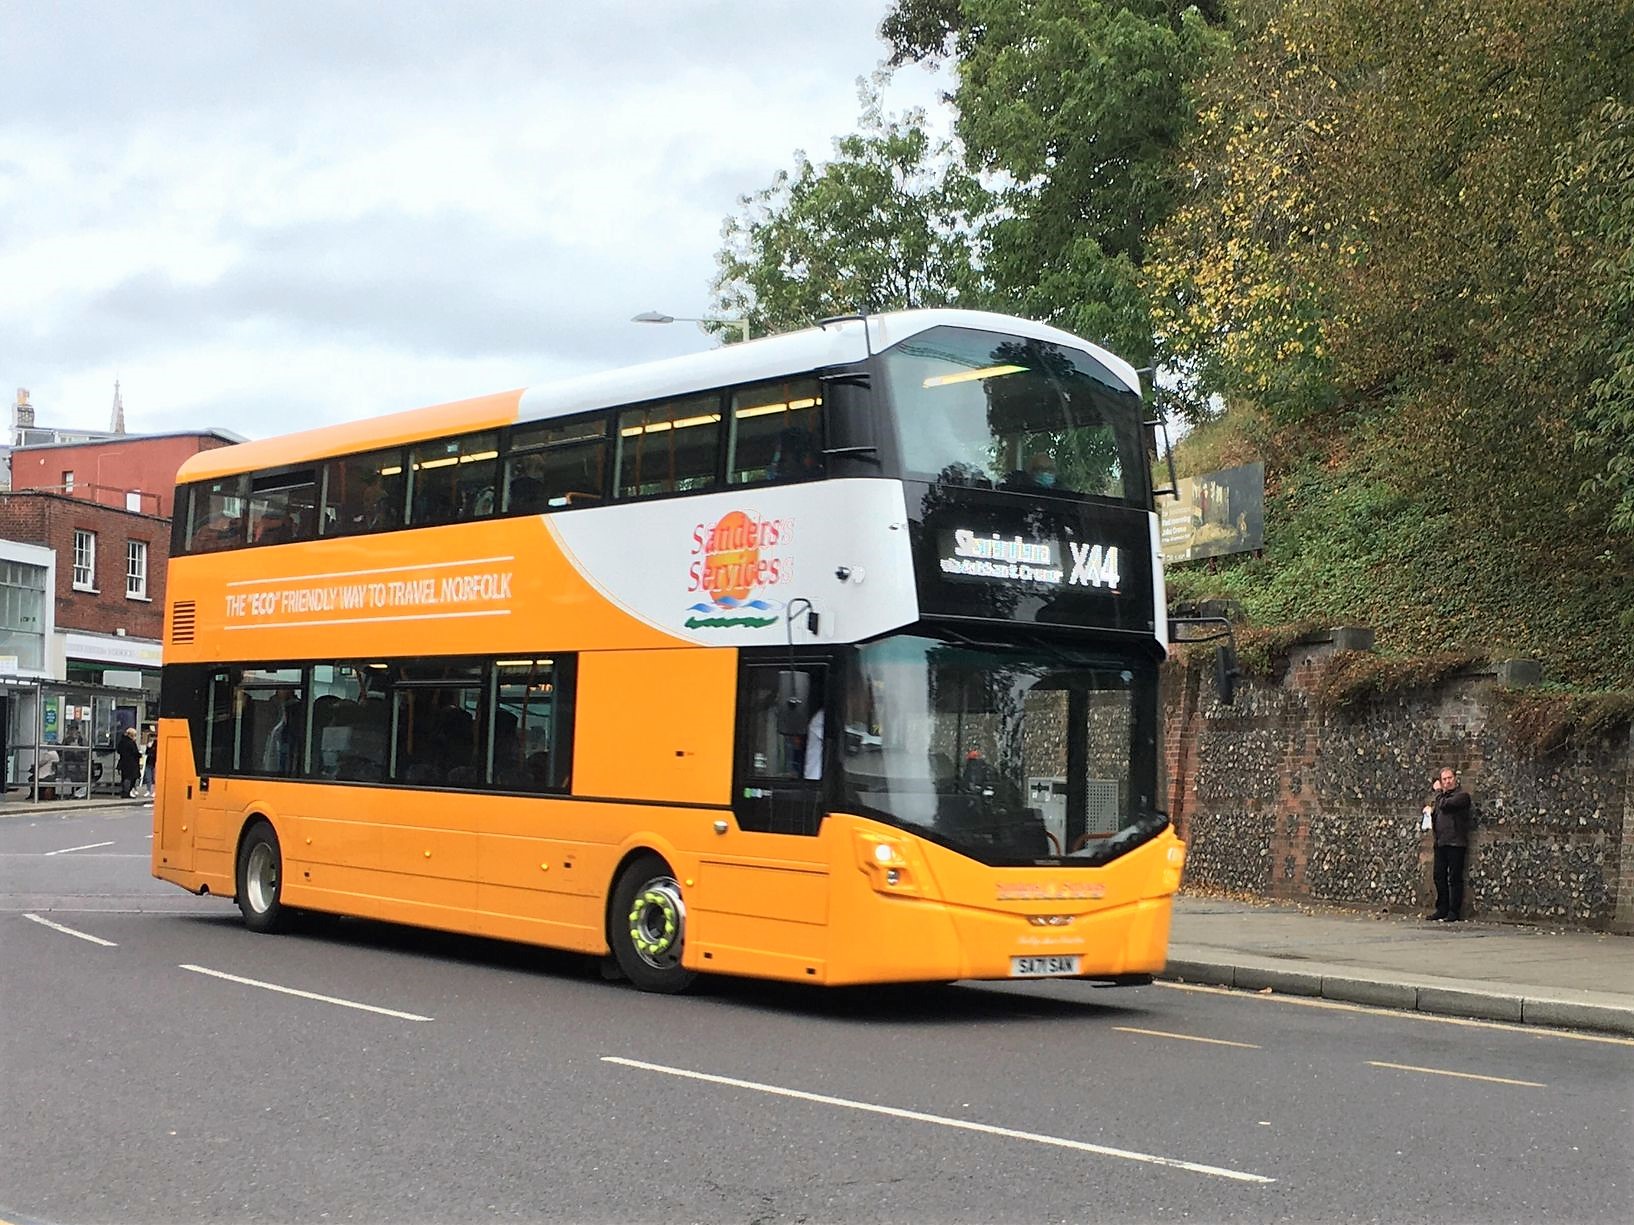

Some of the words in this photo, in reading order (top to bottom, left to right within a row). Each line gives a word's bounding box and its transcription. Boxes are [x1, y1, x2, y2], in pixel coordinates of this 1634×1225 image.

[690, 514, 793, 556] Sanders
[687, 553, 793, 593] Services
[1068, 541, 1121, 589] X44
[225, 594, 247, 617] THE
[281, 586, 338, 614] FRIENDLY
[339, 583, 367, 609] WAY
[368, 582, 386, 608] TO
[387, 579, 438, 606] TRAVEL
[440, 571, 513, 602] NORFOLK
